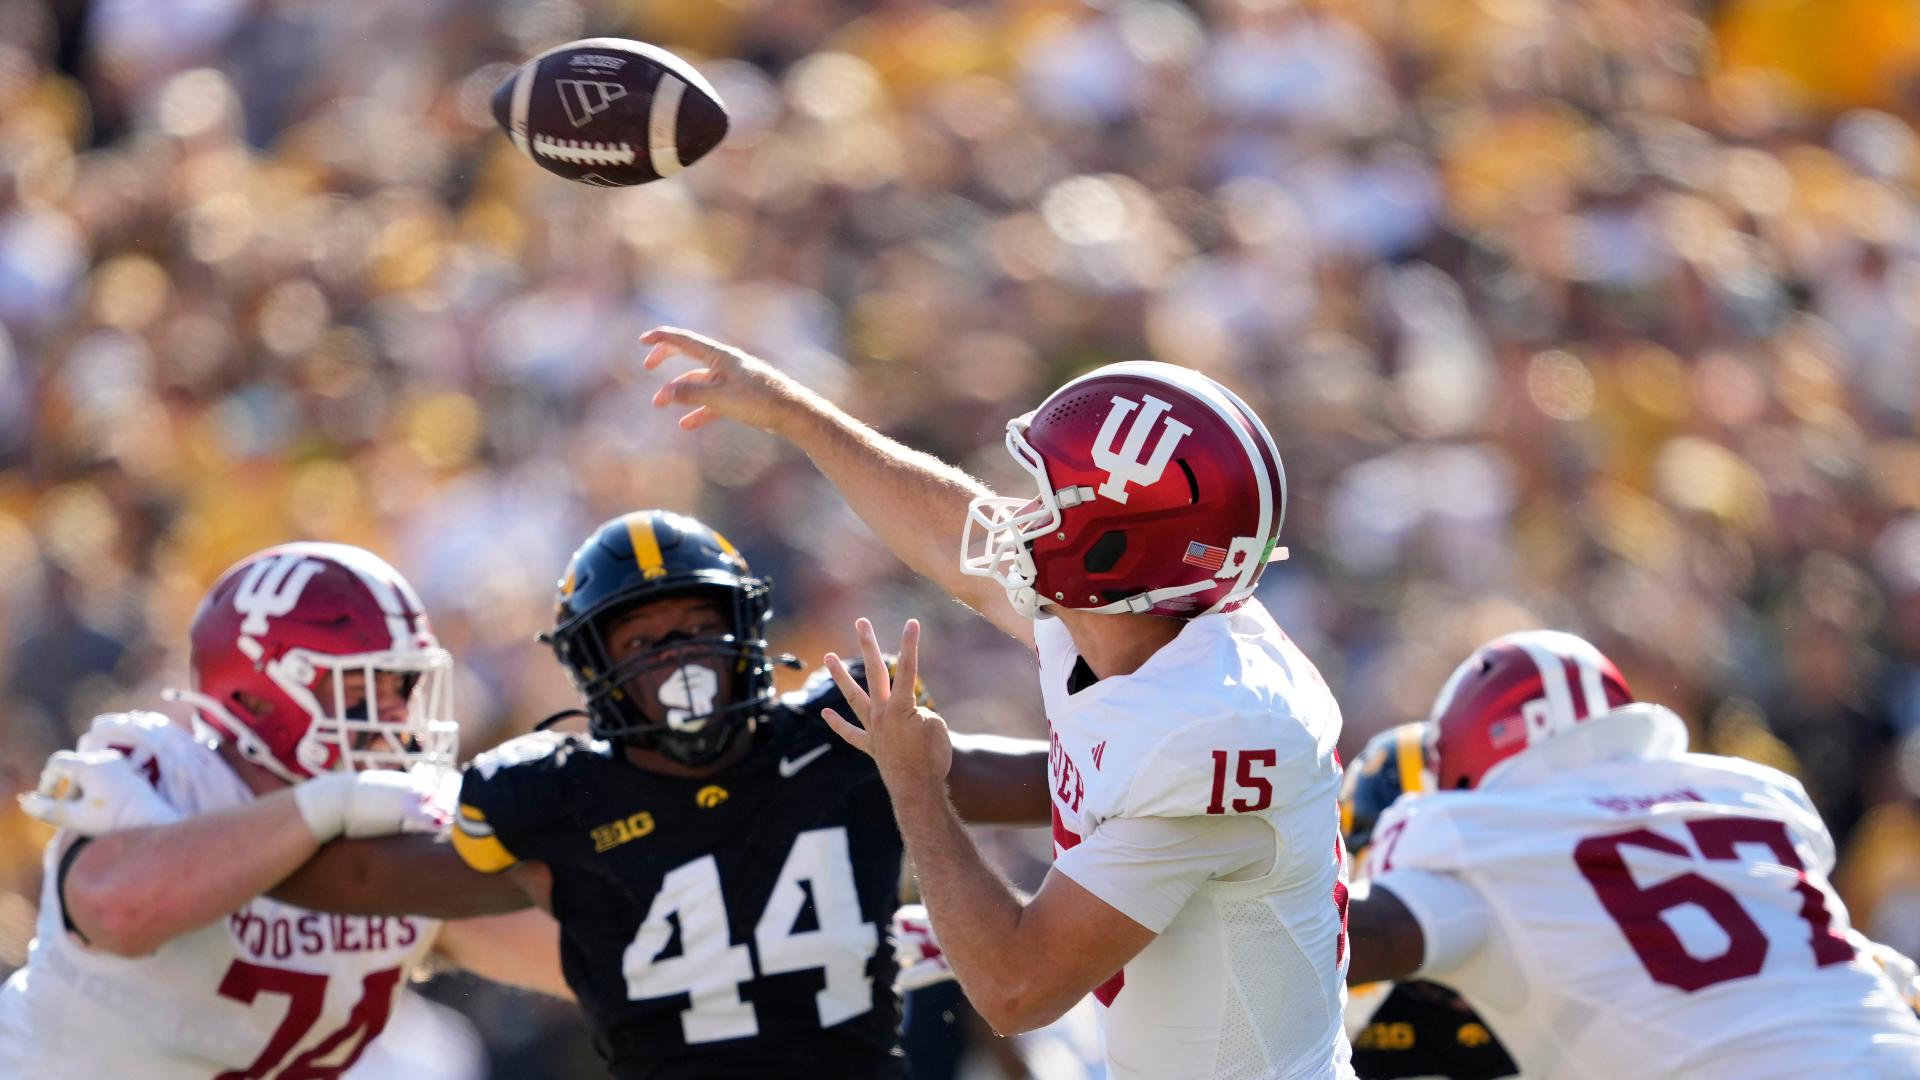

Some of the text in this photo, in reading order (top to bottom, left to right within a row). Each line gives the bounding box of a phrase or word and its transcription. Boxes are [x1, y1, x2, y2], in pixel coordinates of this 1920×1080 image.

[1206, 749, 1277, 815] 15
[621, 826, 879, 1045] 44
[1573, 816, 1858, 992] 67
[213, 958, 403, 1080] 74
